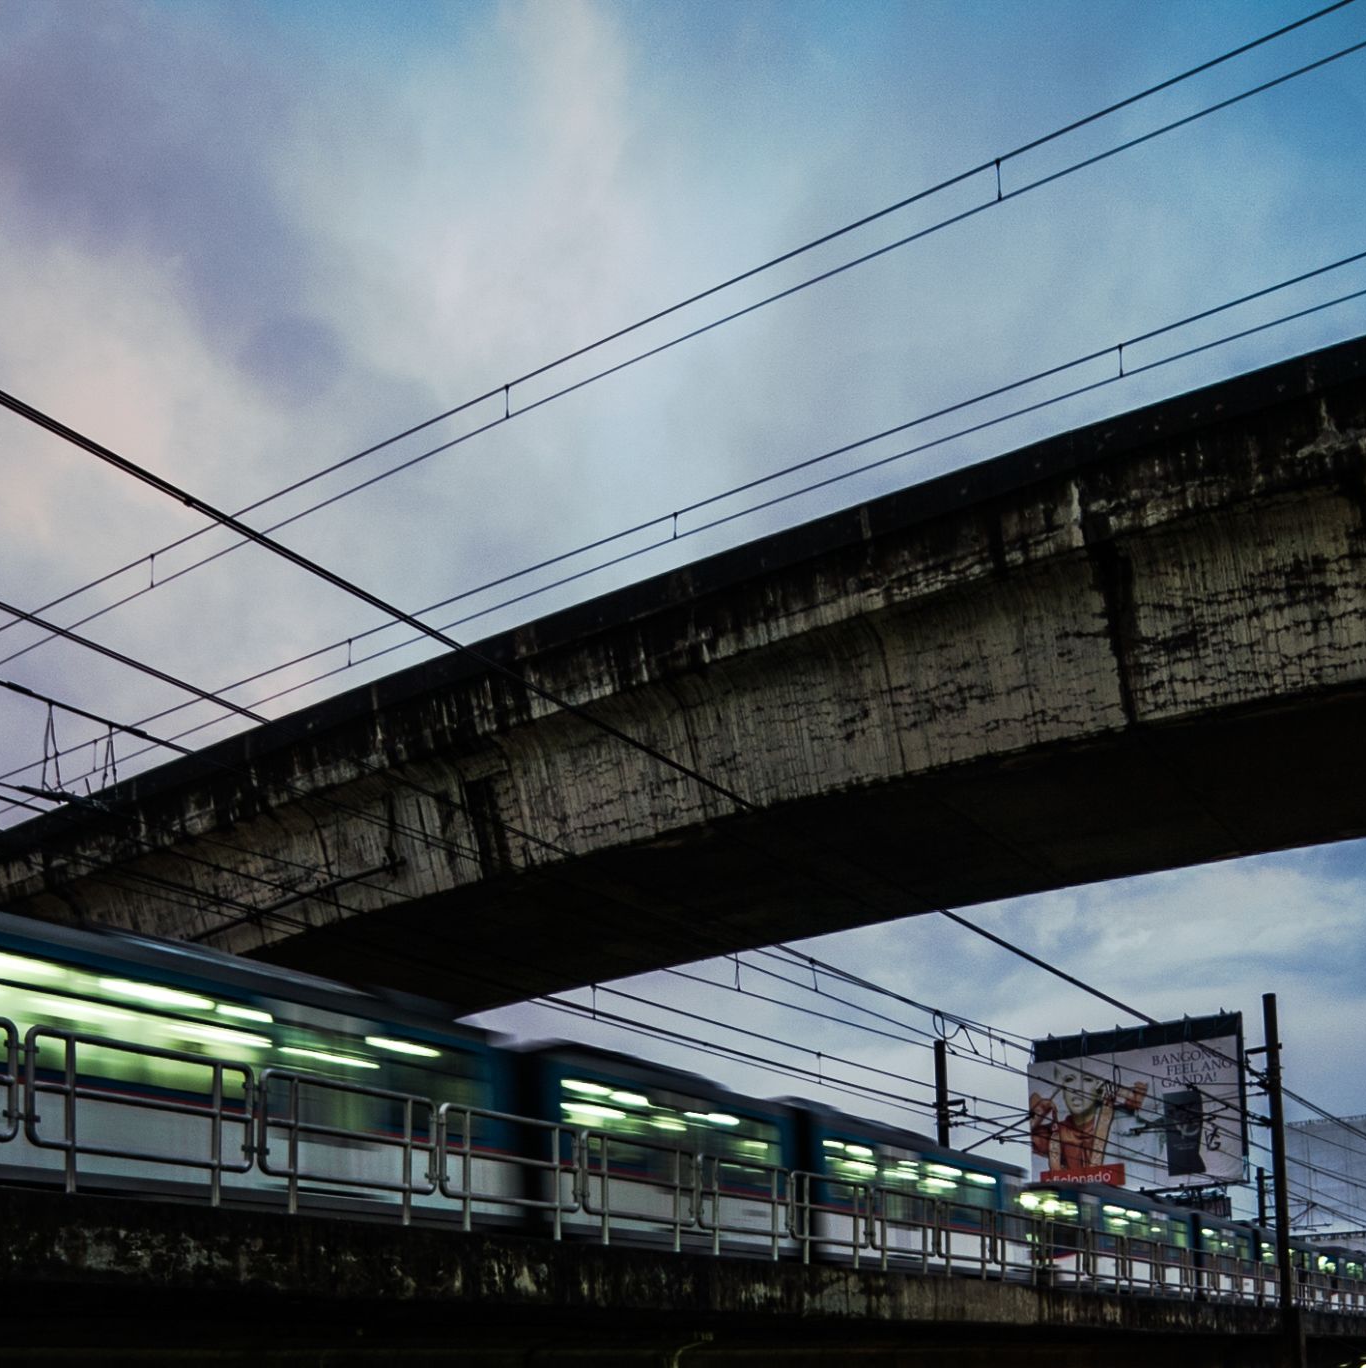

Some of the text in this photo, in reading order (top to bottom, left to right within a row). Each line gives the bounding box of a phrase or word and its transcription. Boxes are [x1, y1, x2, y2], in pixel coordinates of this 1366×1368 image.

[1167, 1059, 1232, 1076] FEEL ANG
[1161, 1072, 1217, 1089] GANDA!
